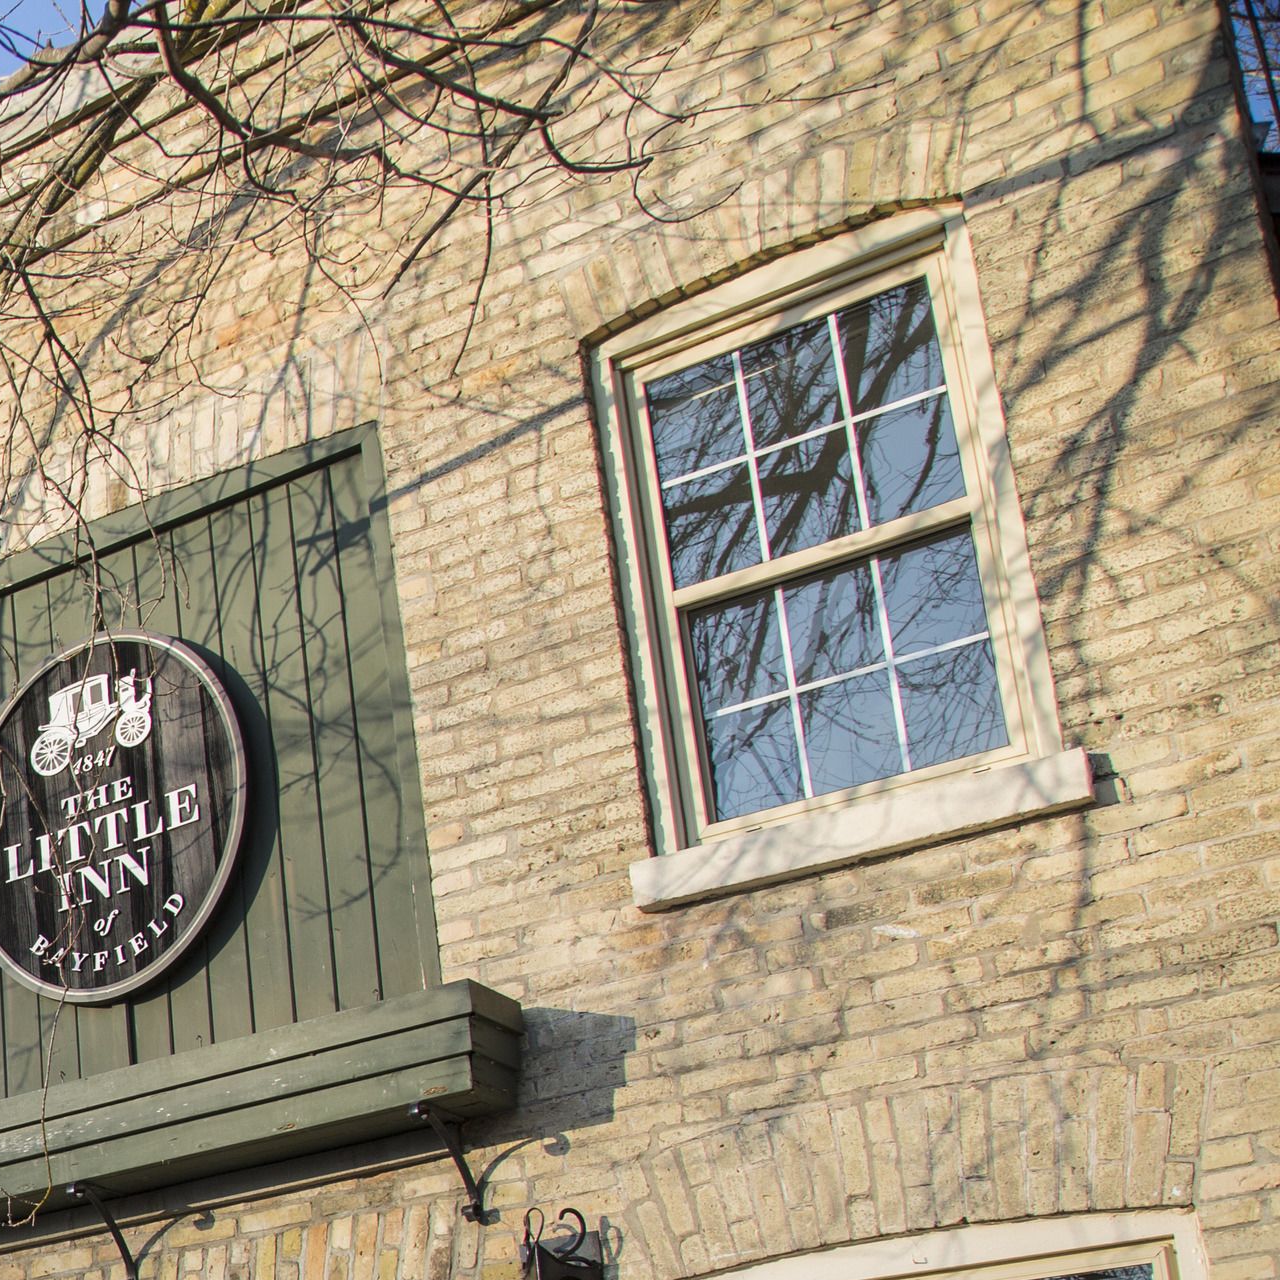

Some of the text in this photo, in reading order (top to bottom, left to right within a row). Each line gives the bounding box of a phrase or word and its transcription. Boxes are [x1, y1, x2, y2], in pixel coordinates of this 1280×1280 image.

[73, 745, 116, 775] 1847
[60, 776, 134, 820] THE
[3, 783, 201, 884] LITTLE
[57, 845, 152, 914] INN
[29, 892, 186, 973] BAYFIELD
[93, 908, 120, 937] of
